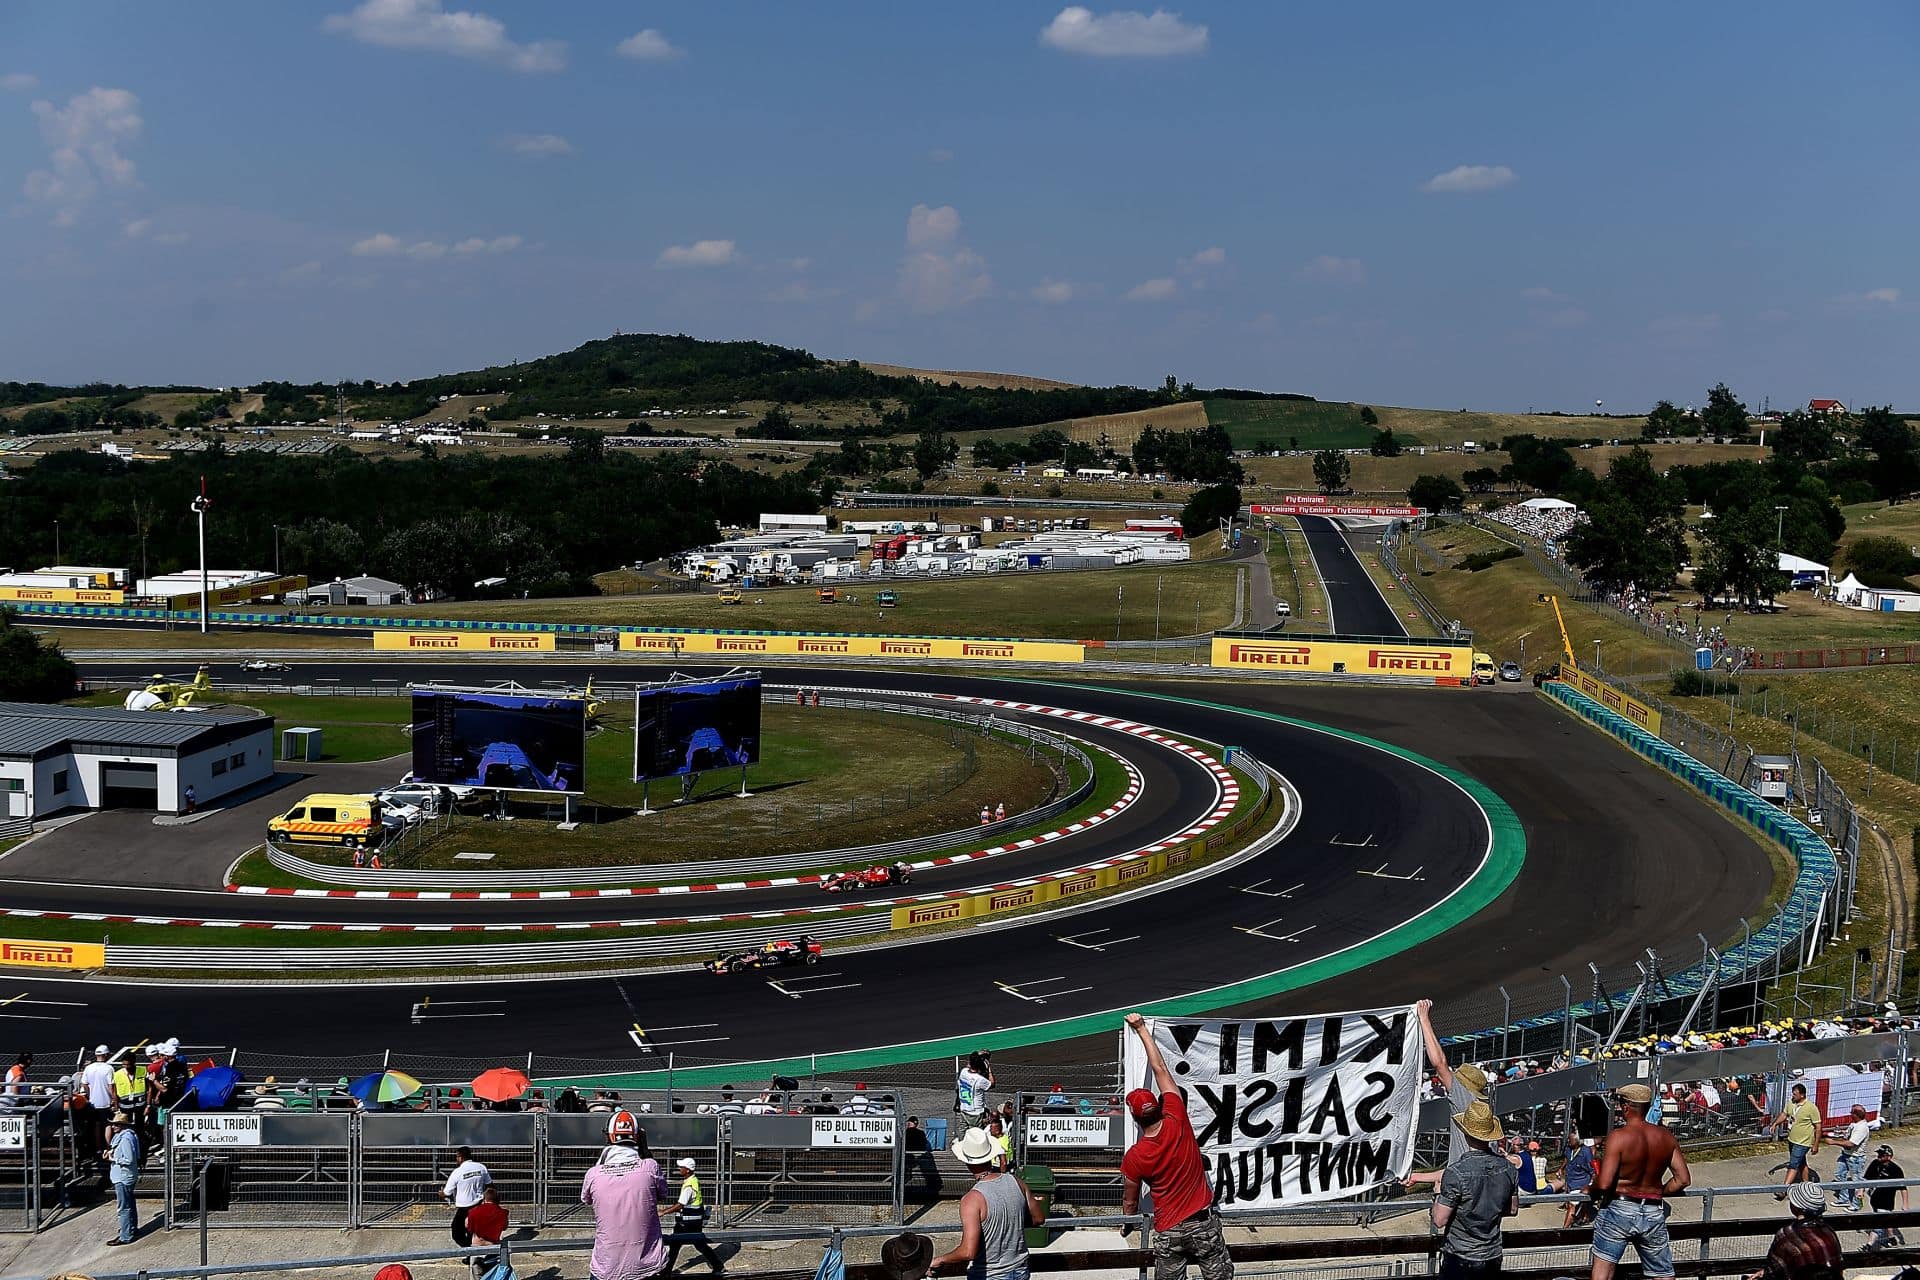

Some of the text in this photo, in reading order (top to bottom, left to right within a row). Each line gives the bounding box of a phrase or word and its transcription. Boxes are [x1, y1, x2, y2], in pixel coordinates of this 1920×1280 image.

[1297, 495, 1325, 504] Emirates
[76, 591, 111, 601] PIRELLI
[409, 635, 539, 649] PIRELLI PIRELLI
[716, 638, 767, 651] PIRELLI
[798, 640, 848, 652] PIRELLI
[881, 641, 931, 654] PIRELLI
[963, 644, 1014, 657] PIRELLI
[1230, 644, 1452, 670] PIRELLI PIRELLI
[1118, 861, 1150, 881] PIRELLI
[1060, 875, 1097, 896] PIRELLI
[989, 889, 1034, 910] PIRELLI
[909, 903, 960, 924] PIRELLI
[3, 944, 73, 963] PIRELLI
[176, 1118, 195, 1130] RED
[197, 1118, 221, 1130] BULL
[815, 1120, 833, 1132] RED
[835, 1120, 857, 1132] BULL
[1030, 1119, 1048, 1131] RED
[1050, 1119, 1072, 1131] BULL
[191, 1133, 202, 1143] K
[833, 1134, 879, 1144] L SZEKTOR
[1043, 1134, 1056, 1143] M
